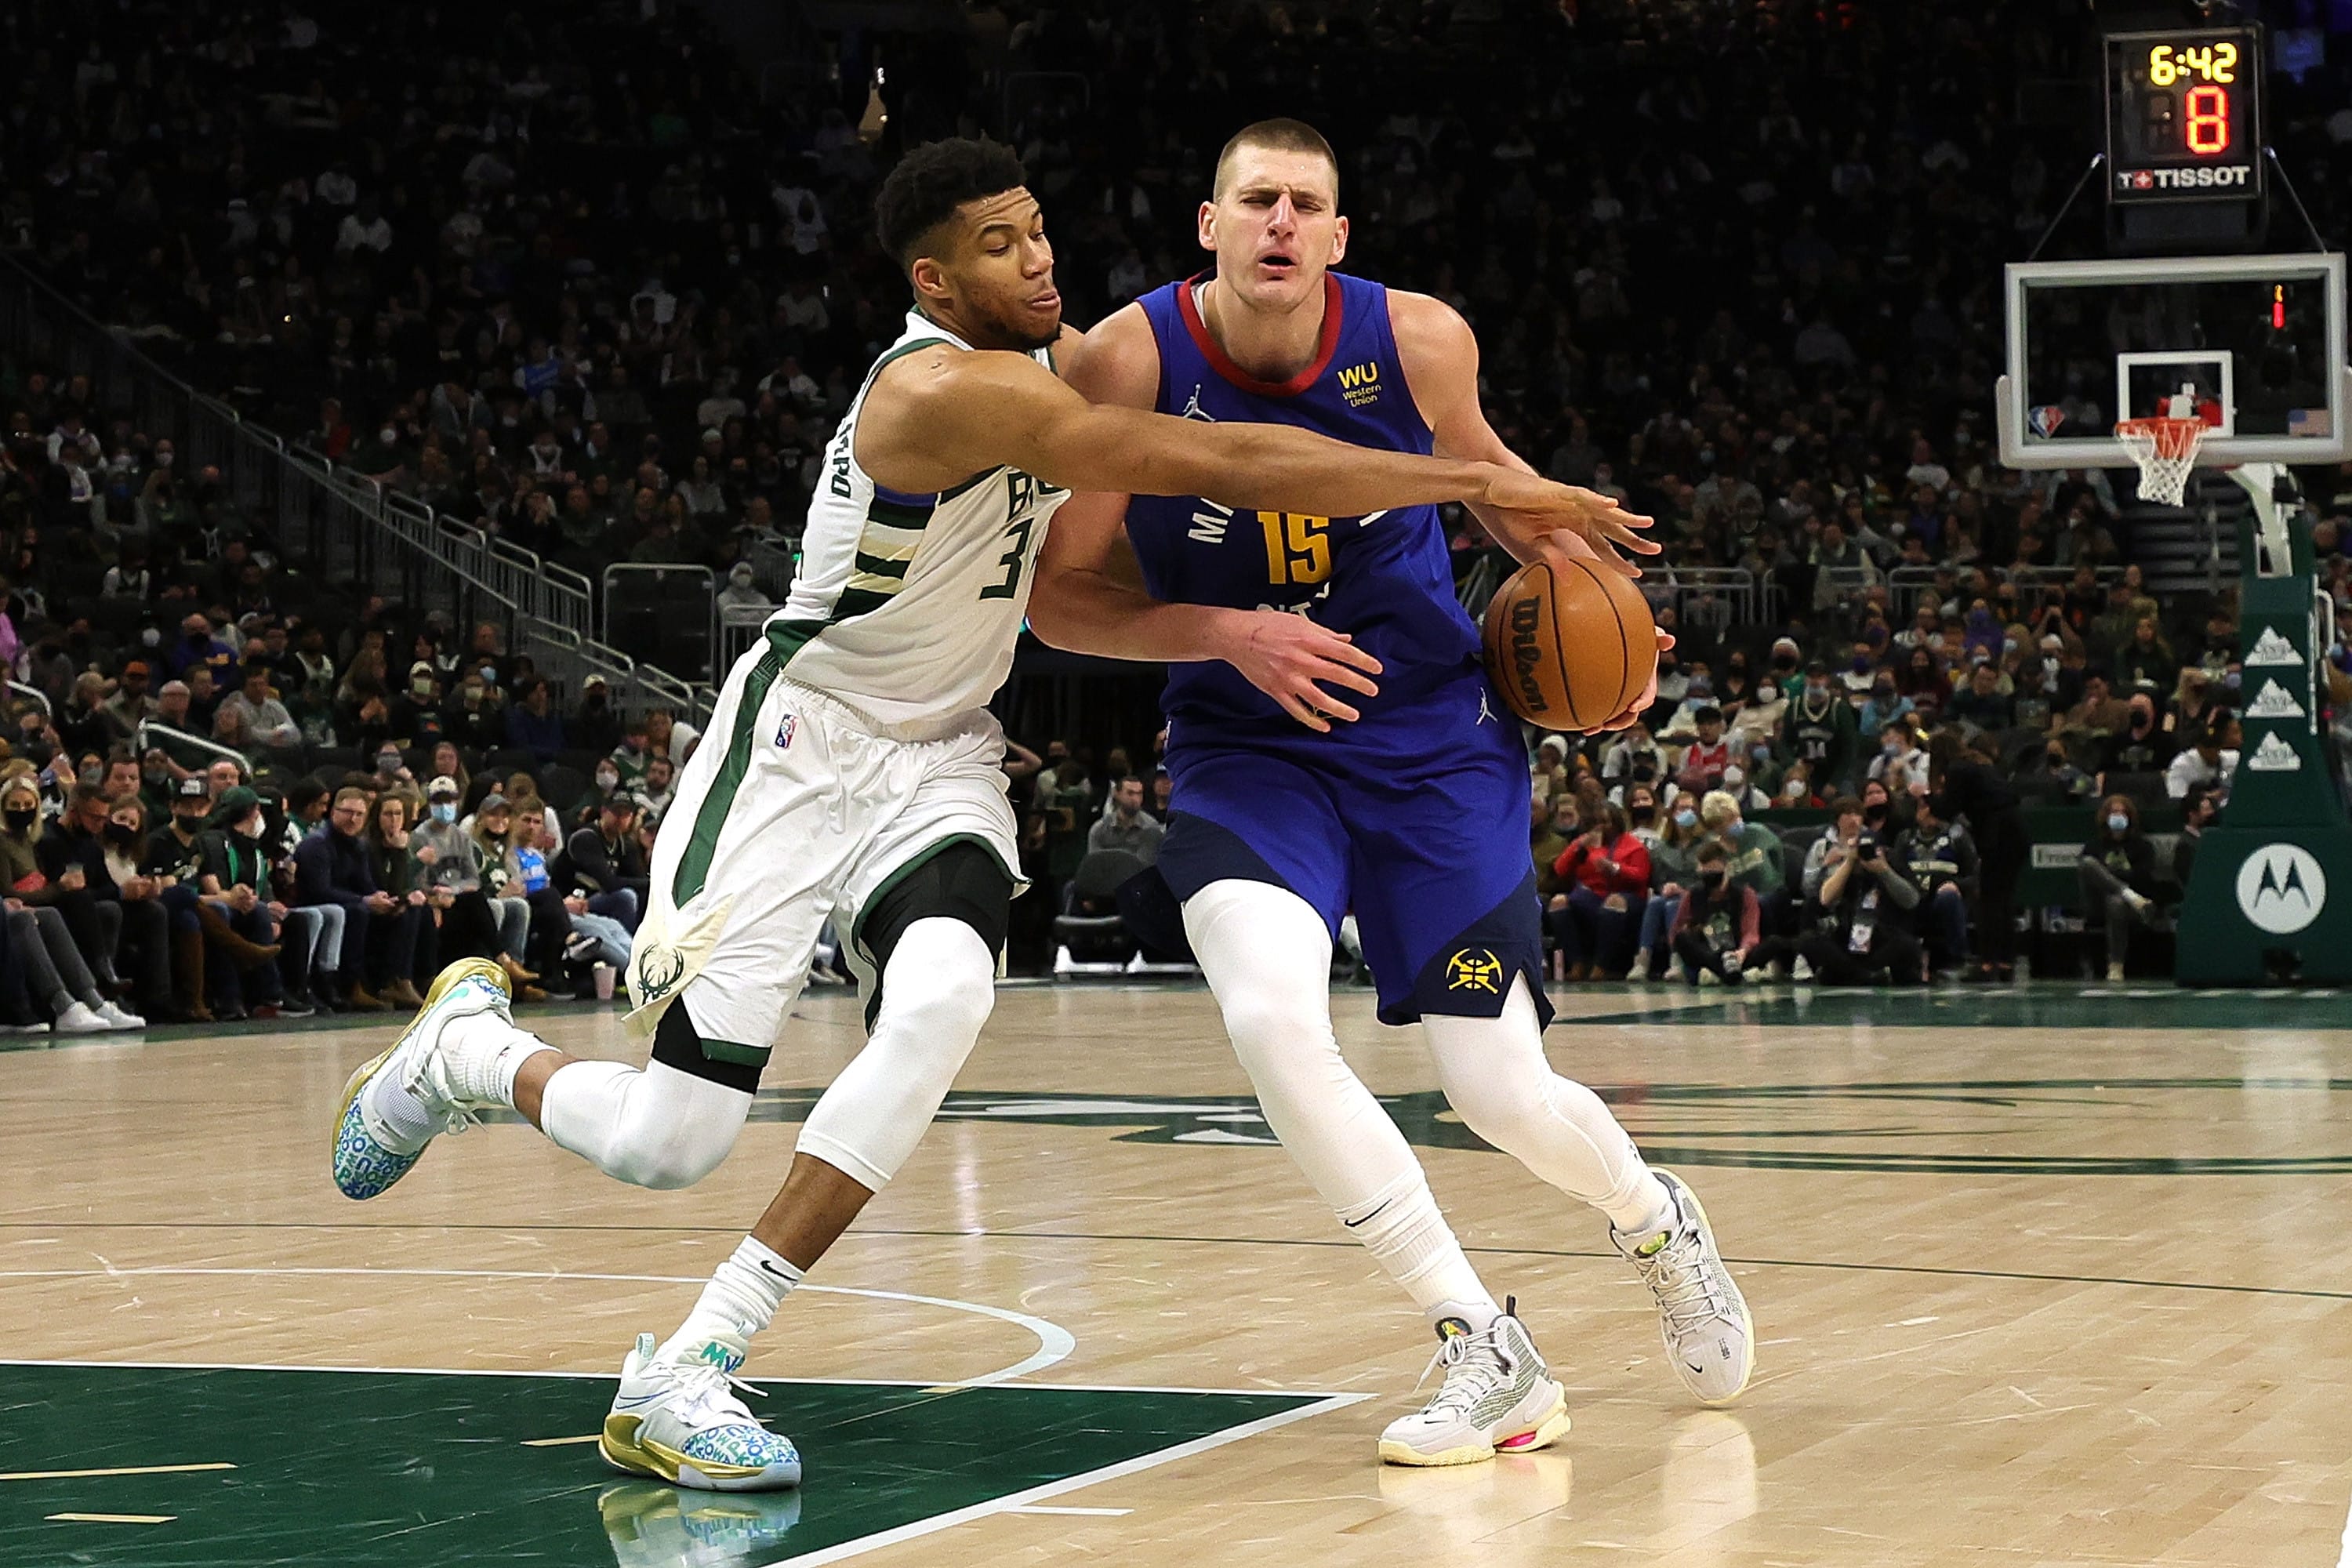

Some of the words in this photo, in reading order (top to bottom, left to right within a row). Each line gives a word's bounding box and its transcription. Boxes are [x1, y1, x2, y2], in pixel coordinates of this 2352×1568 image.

[2150, 43, 2238, 85] 6:42
[2186, 85, 2230, 154] 8
[2154, 165, 2250, 188] TISSOT
[1338, 361, 1378, 389] WU
[1342, 384, 1381, 400] Western
[1350, 394, 1378, 407] Union
[1257, 511, 1331, 584] 15
